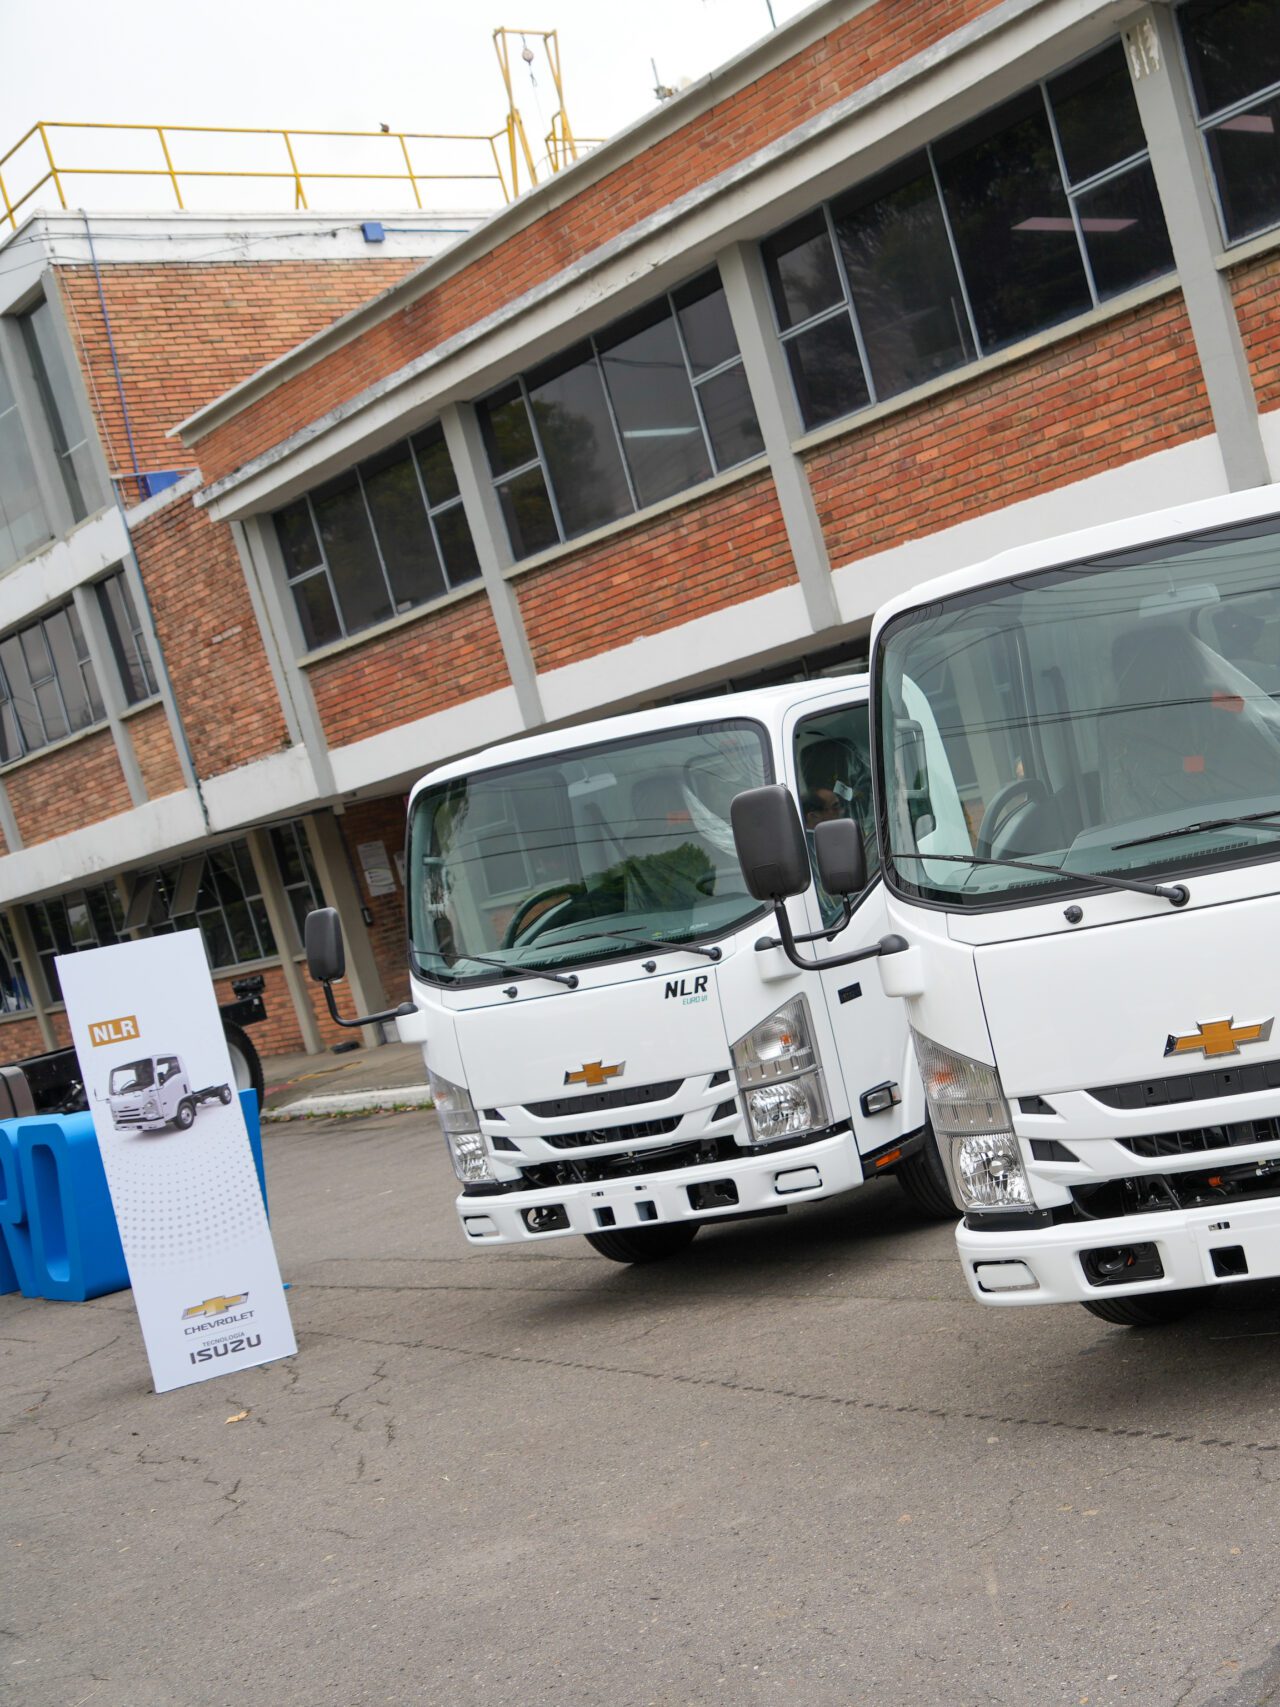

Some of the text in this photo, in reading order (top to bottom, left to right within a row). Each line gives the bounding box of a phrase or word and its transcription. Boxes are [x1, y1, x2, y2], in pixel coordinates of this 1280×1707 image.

[664, 975, 708, 1000] NLR
[92, 1020, 136, 1043] NLR
[183, 1310, 255, 1336] CHEVROLET
[189, 1333, 262, 1365] ISUZU
